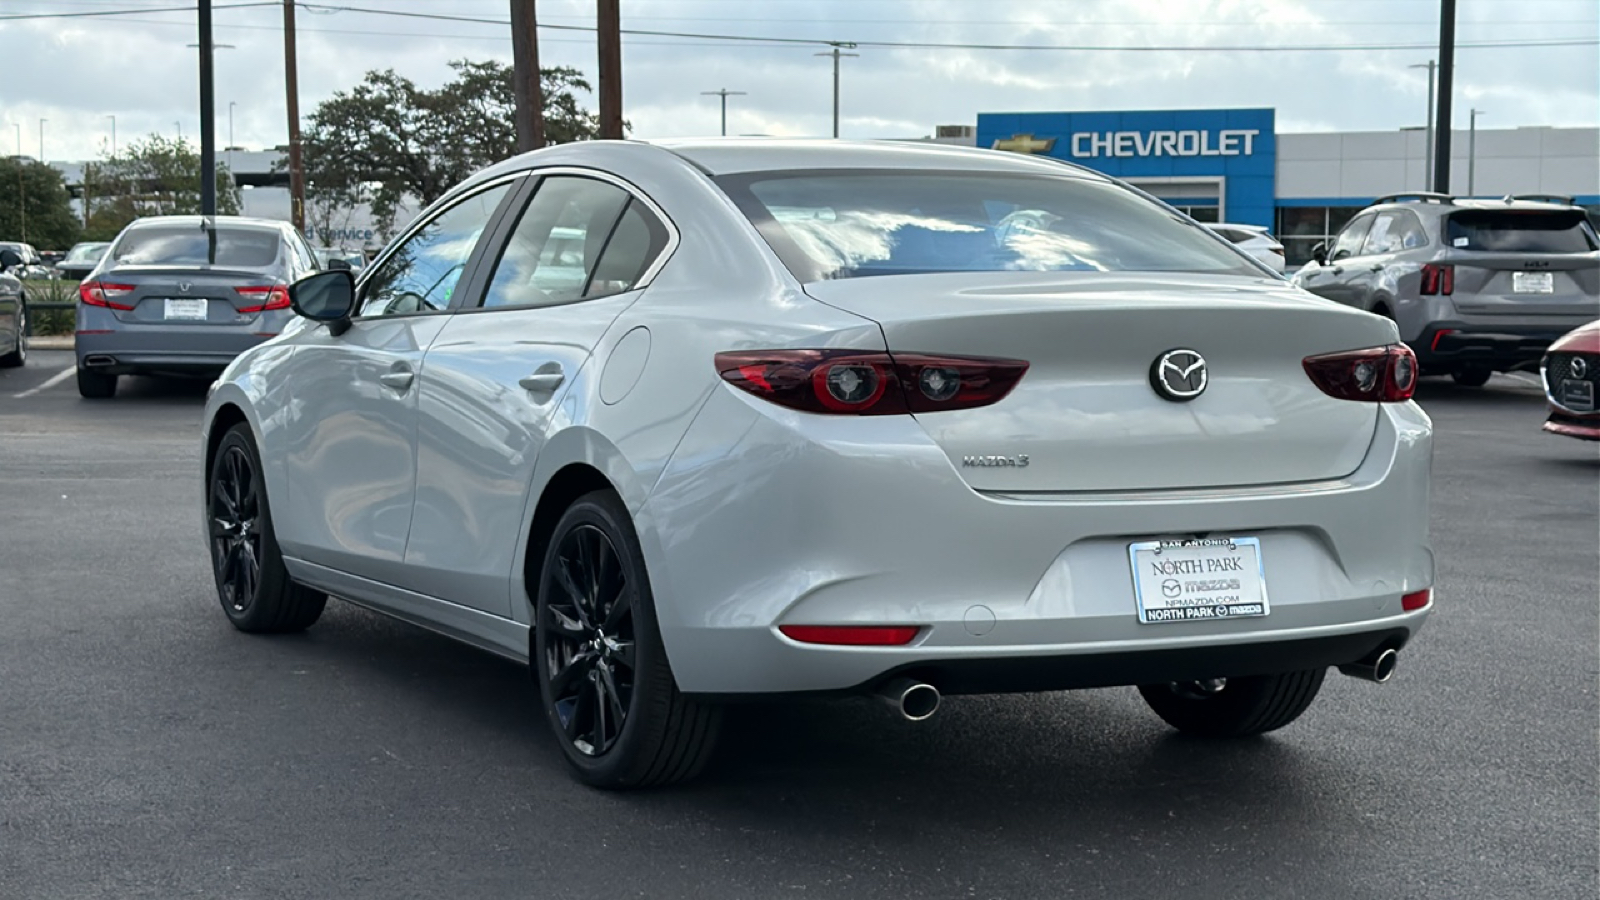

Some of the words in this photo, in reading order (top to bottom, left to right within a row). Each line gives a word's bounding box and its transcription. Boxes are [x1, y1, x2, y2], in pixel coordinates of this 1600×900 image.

[1071, 129, 1260, 158] CHEVROLET
[1161, 540, 1182, 548] SAN
[1184, 539, 1230, 547] ANTONIO
[1151, 558, 1204, 576] NORTH
[1207, 557, 1243, 572] PARK
[1165, 596, 1240, 607] NPMAZDA.COM
[1148, 608, 1185, 621] NORTH
[1186, 606, 1215, 619] PARK
